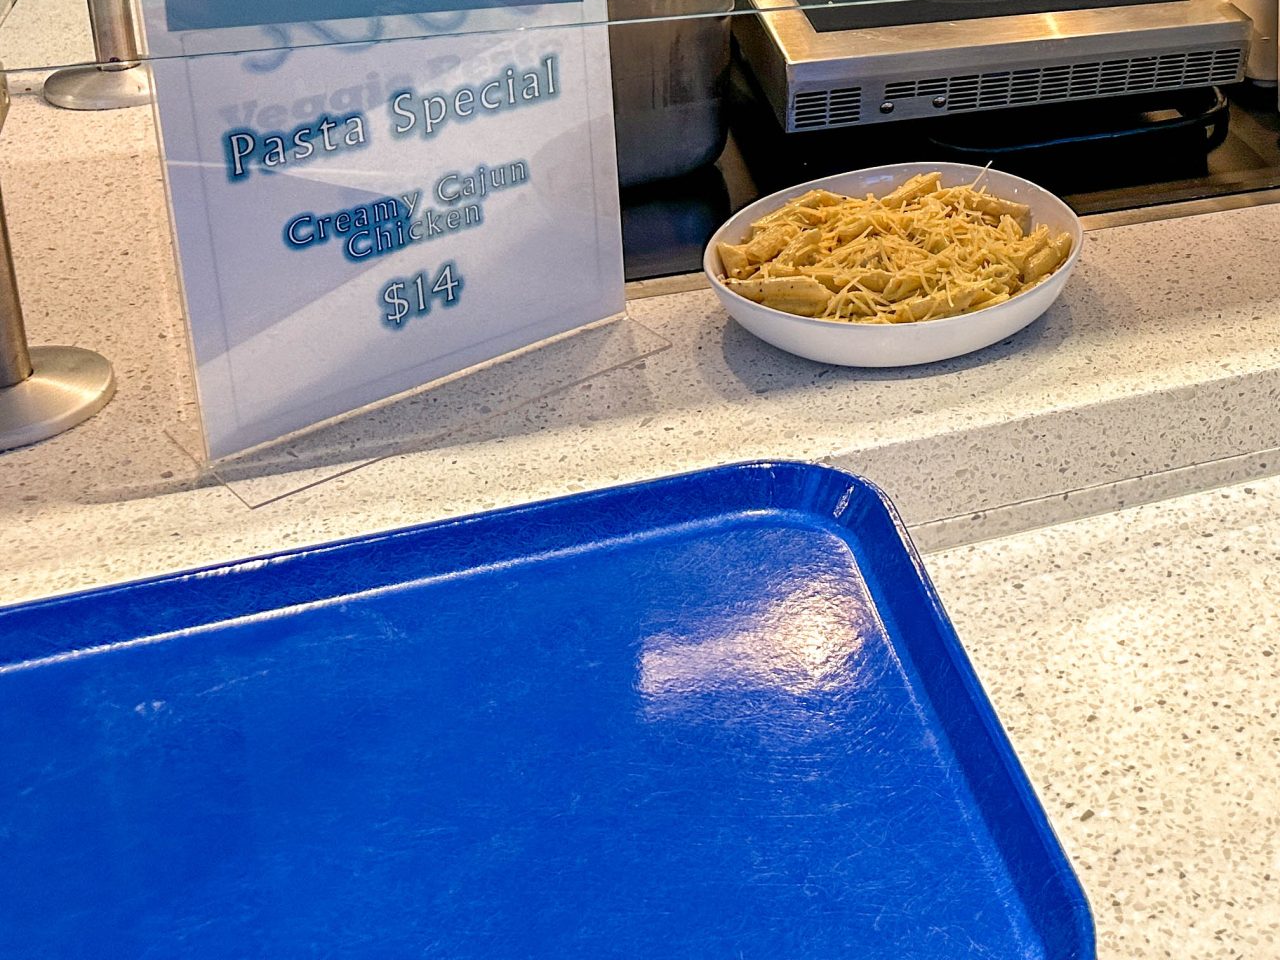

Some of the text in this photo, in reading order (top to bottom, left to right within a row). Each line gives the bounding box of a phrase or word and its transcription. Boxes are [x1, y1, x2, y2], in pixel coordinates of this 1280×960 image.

[231, 115, 366, 177] Pasta
[392, 56, 557, 136] Special
[288, 161, 526, 245] Creamy Cajun
[346, 204, 481, 258] Chicken
[383, 264, 459, 324] $14
